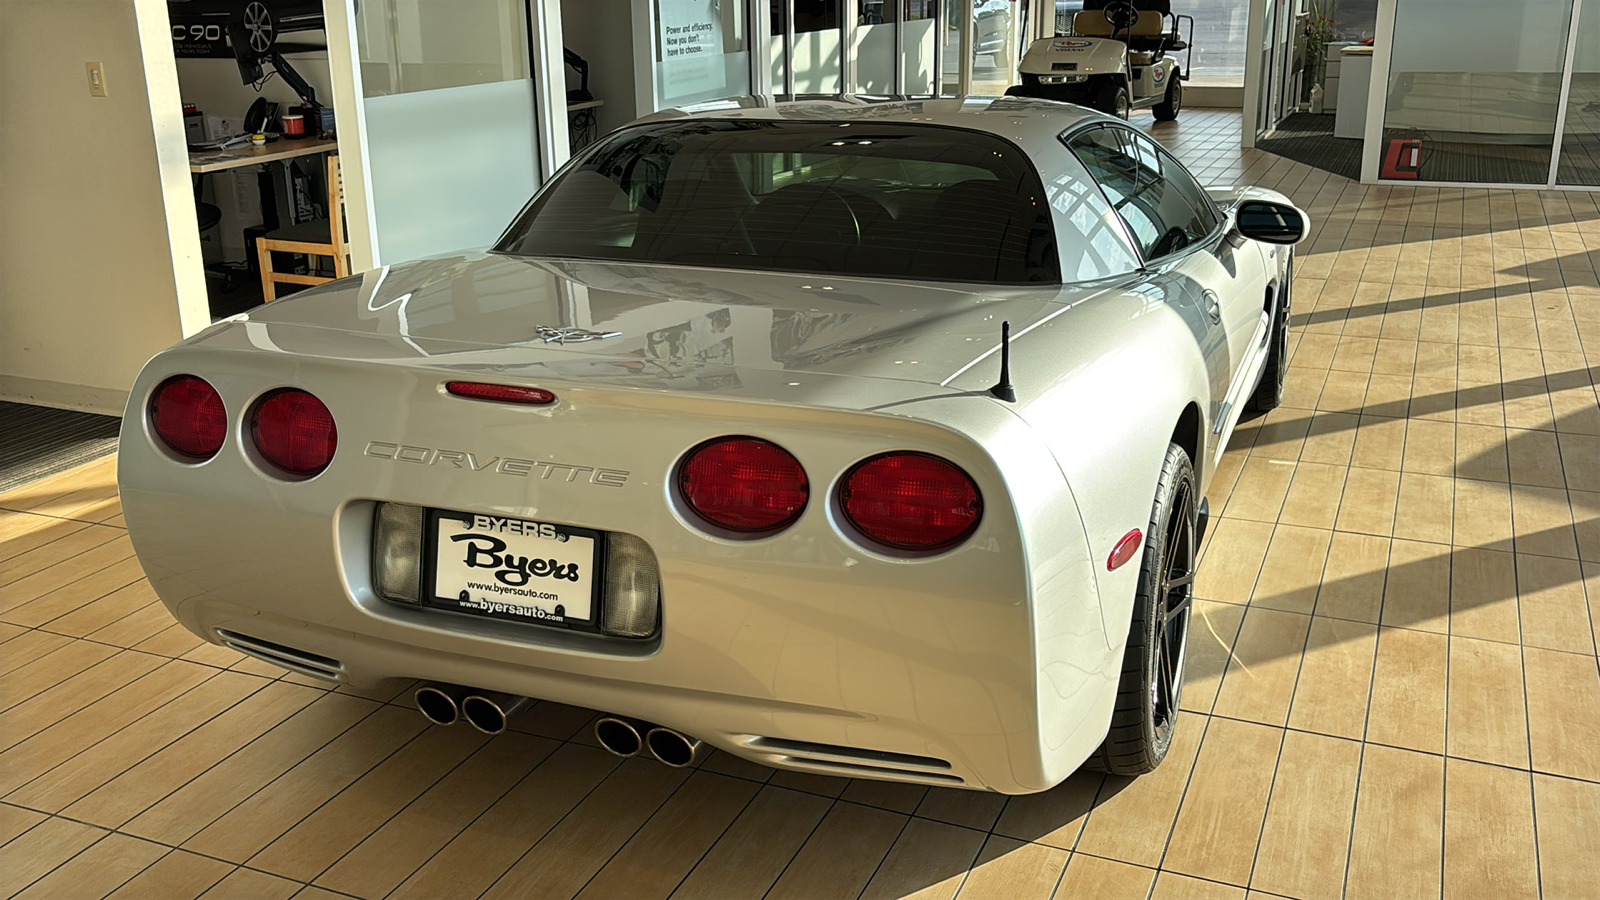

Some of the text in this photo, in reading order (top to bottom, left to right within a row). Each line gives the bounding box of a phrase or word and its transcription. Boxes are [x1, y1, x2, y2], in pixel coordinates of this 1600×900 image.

[666, 22, 713, 35] Power and efficiency.
[666, 34, 700, 46] Now you don't
[667, 45, 703, 57] have to choose.
[364, 441, 630, 488] CORVETTE
[473, 514, 557, 540] BYERS
[450, 533, 579, 587] Byers
[467, 581, 559, 601] www.byersauto.com
[459, 598, 564, 622] www.byersauto.com
